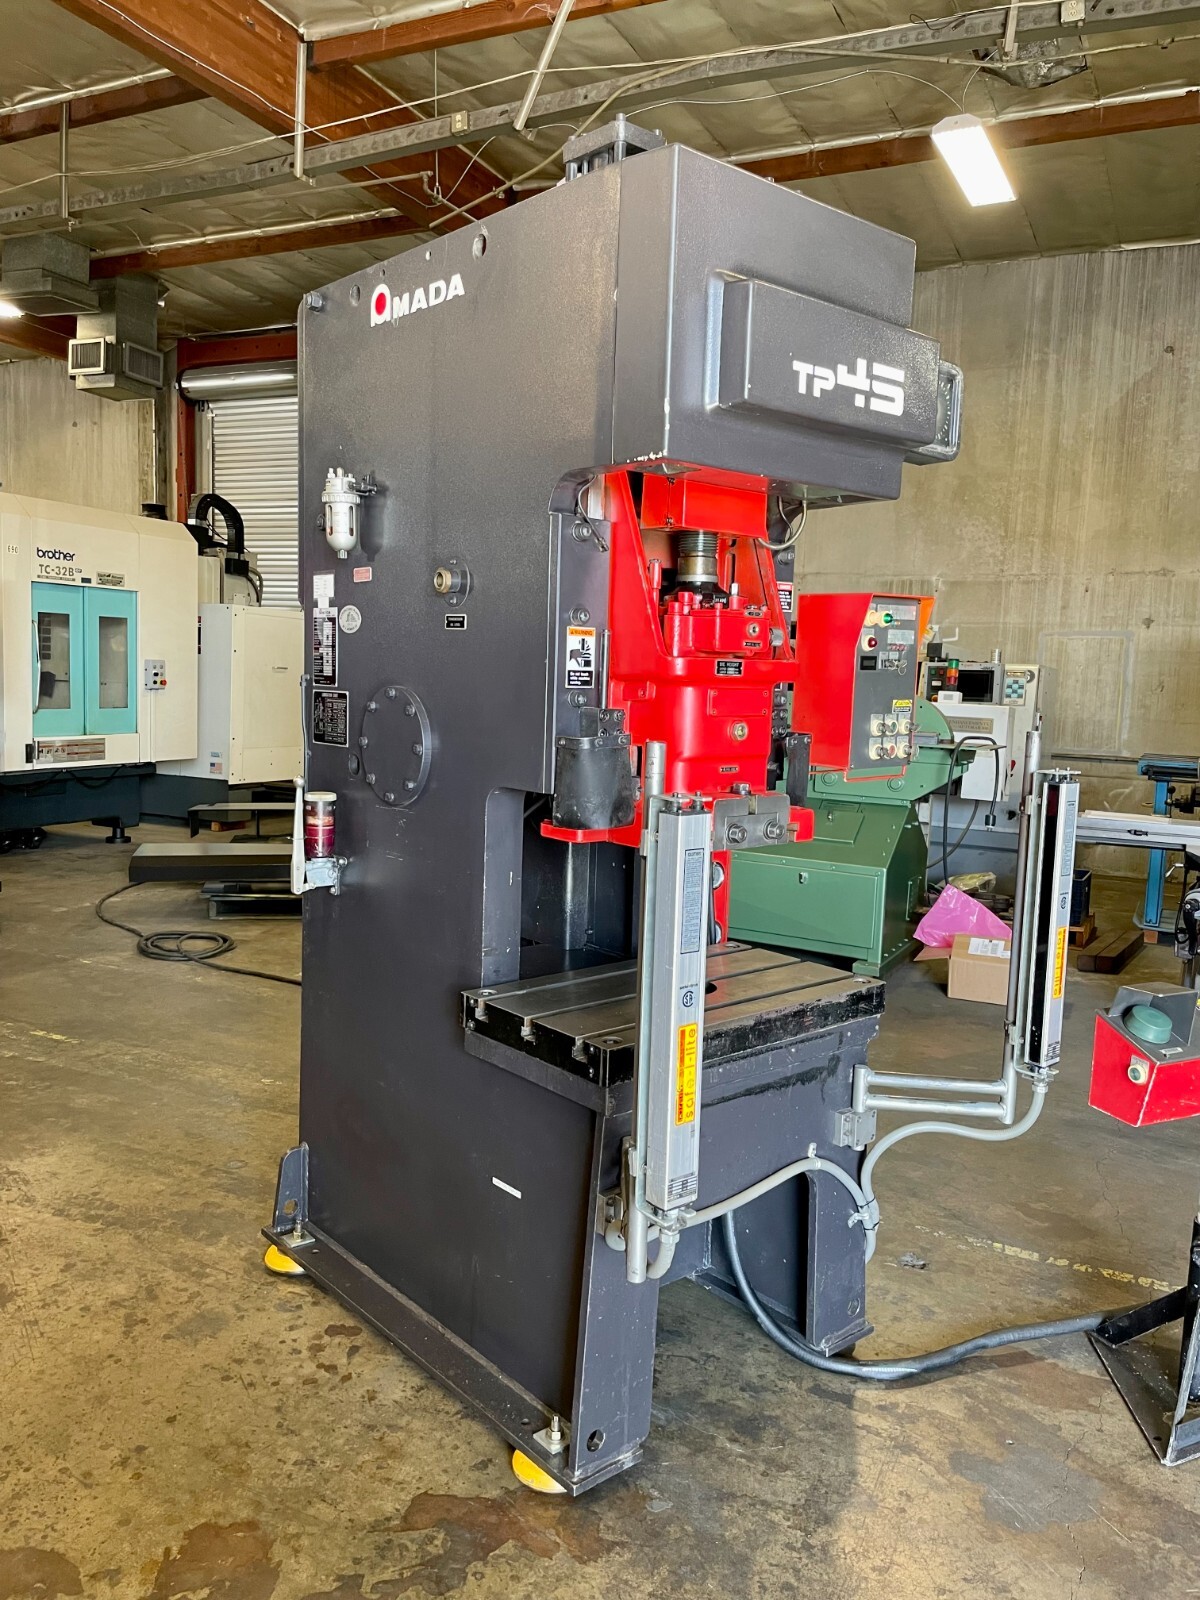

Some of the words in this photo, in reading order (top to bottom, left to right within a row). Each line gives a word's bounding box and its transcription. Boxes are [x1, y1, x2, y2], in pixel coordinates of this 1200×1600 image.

[370, 273, 466, 327] AMADA
[36, 547, 76, 562] brother
[39, 564, 75, 577] TC-32B
